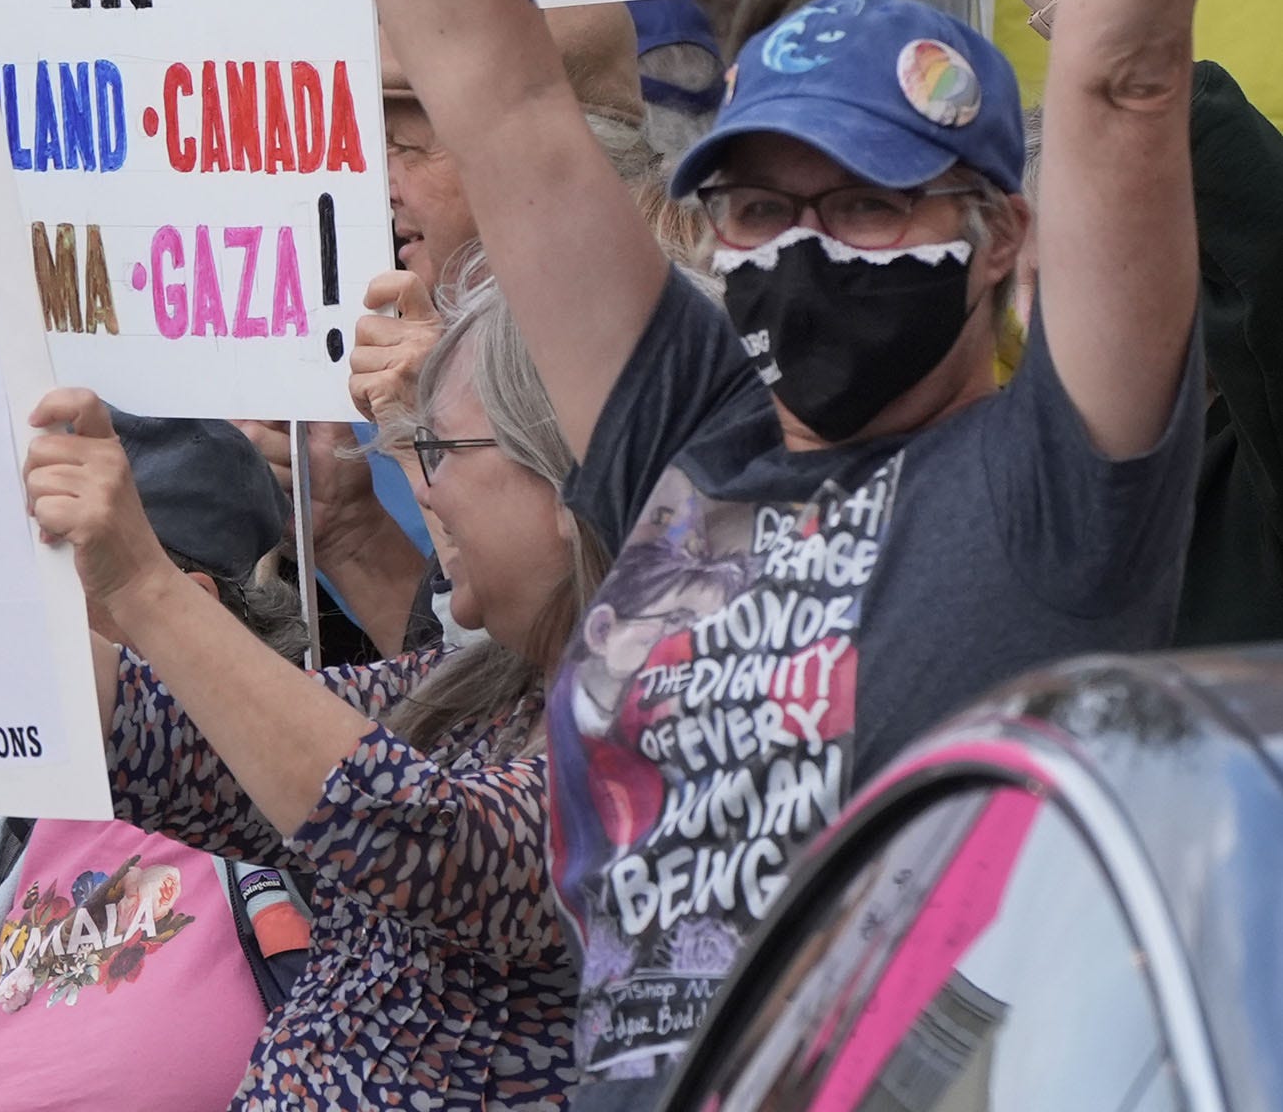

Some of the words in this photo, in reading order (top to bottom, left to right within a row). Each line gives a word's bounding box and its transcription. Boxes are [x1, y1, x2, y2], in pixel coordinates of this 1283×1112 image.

[163, 60, 367, 175] CANADA
[685, 633, 852, 727] DIGNITY
[676, 698, 830, 773] EVERY
[647, 744, 843, 848] HUMAN
[610, 837, 791, 937] BEING
